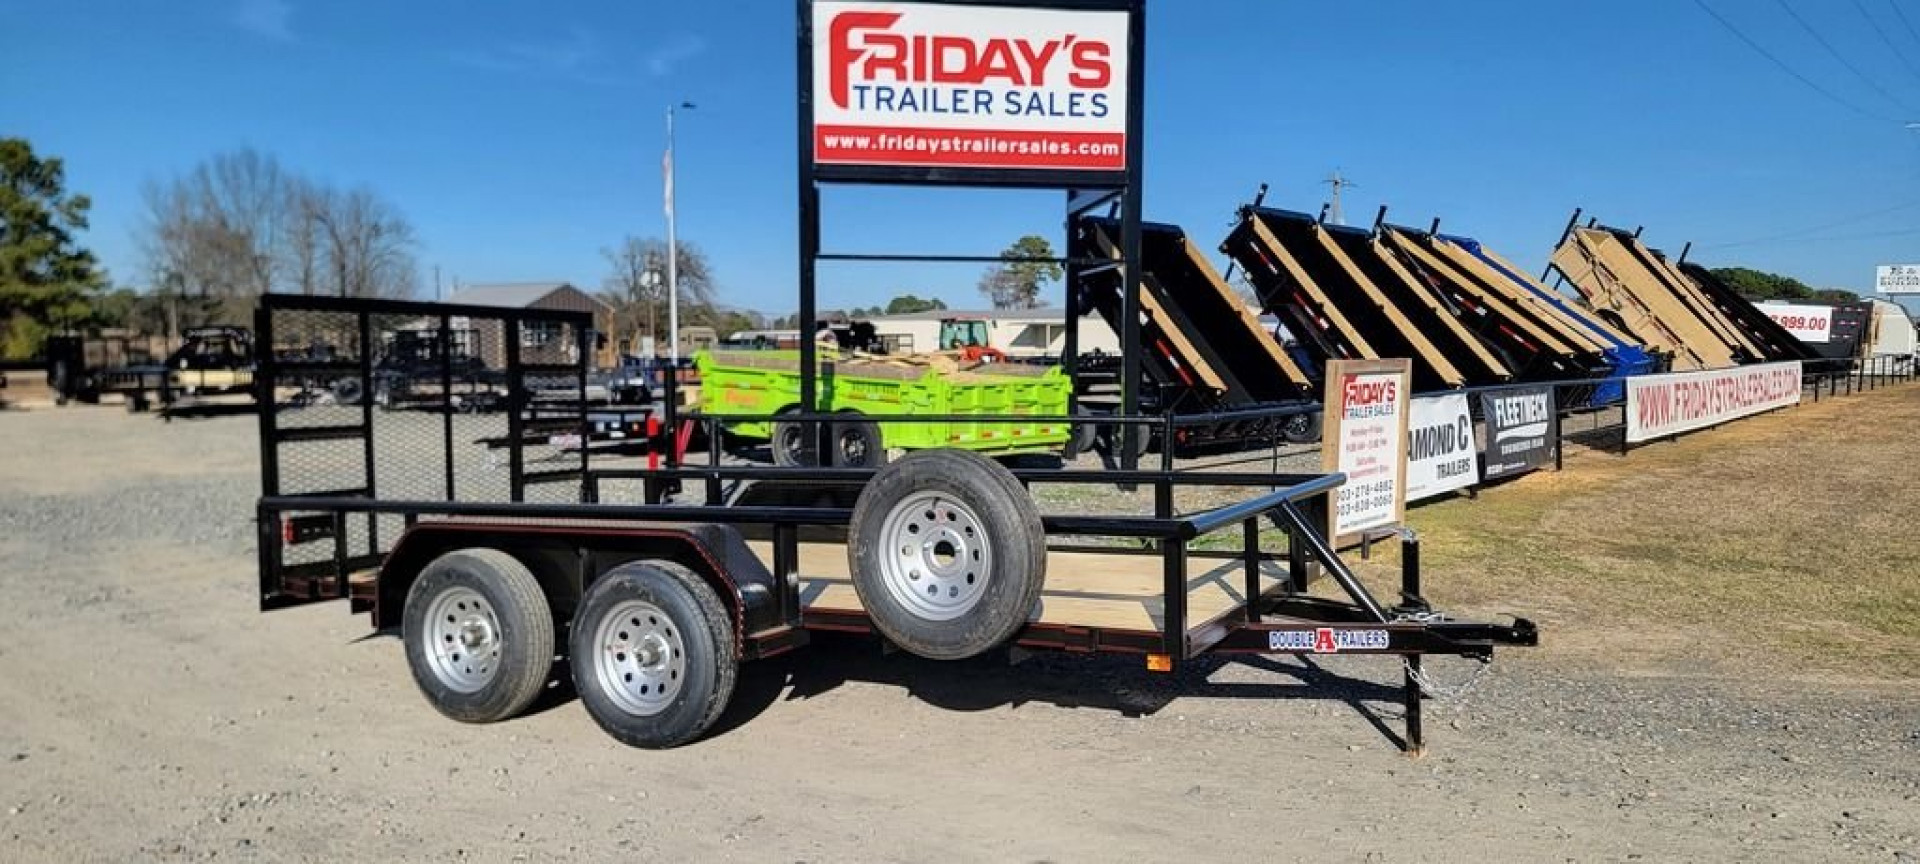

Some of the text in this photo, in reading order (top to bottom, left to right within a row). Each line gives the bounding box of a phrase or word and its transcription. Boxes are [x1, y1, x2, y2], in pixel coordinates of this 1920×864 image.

[829, 11, 1111, 109] FRIDAY'S
[853, 85, 1109, 118] TRAILER SALES
[824, 133, 1119, 156] www.fridaystrailersales.com
[1342, 374, 1396, 420] FRIDAY'S
[1457, 413, 1469, 451] C
[1436, 458, 1471, 481] TRAILERS
[1269, 628, 1389, 651] DOUBLE A TRAILERS
